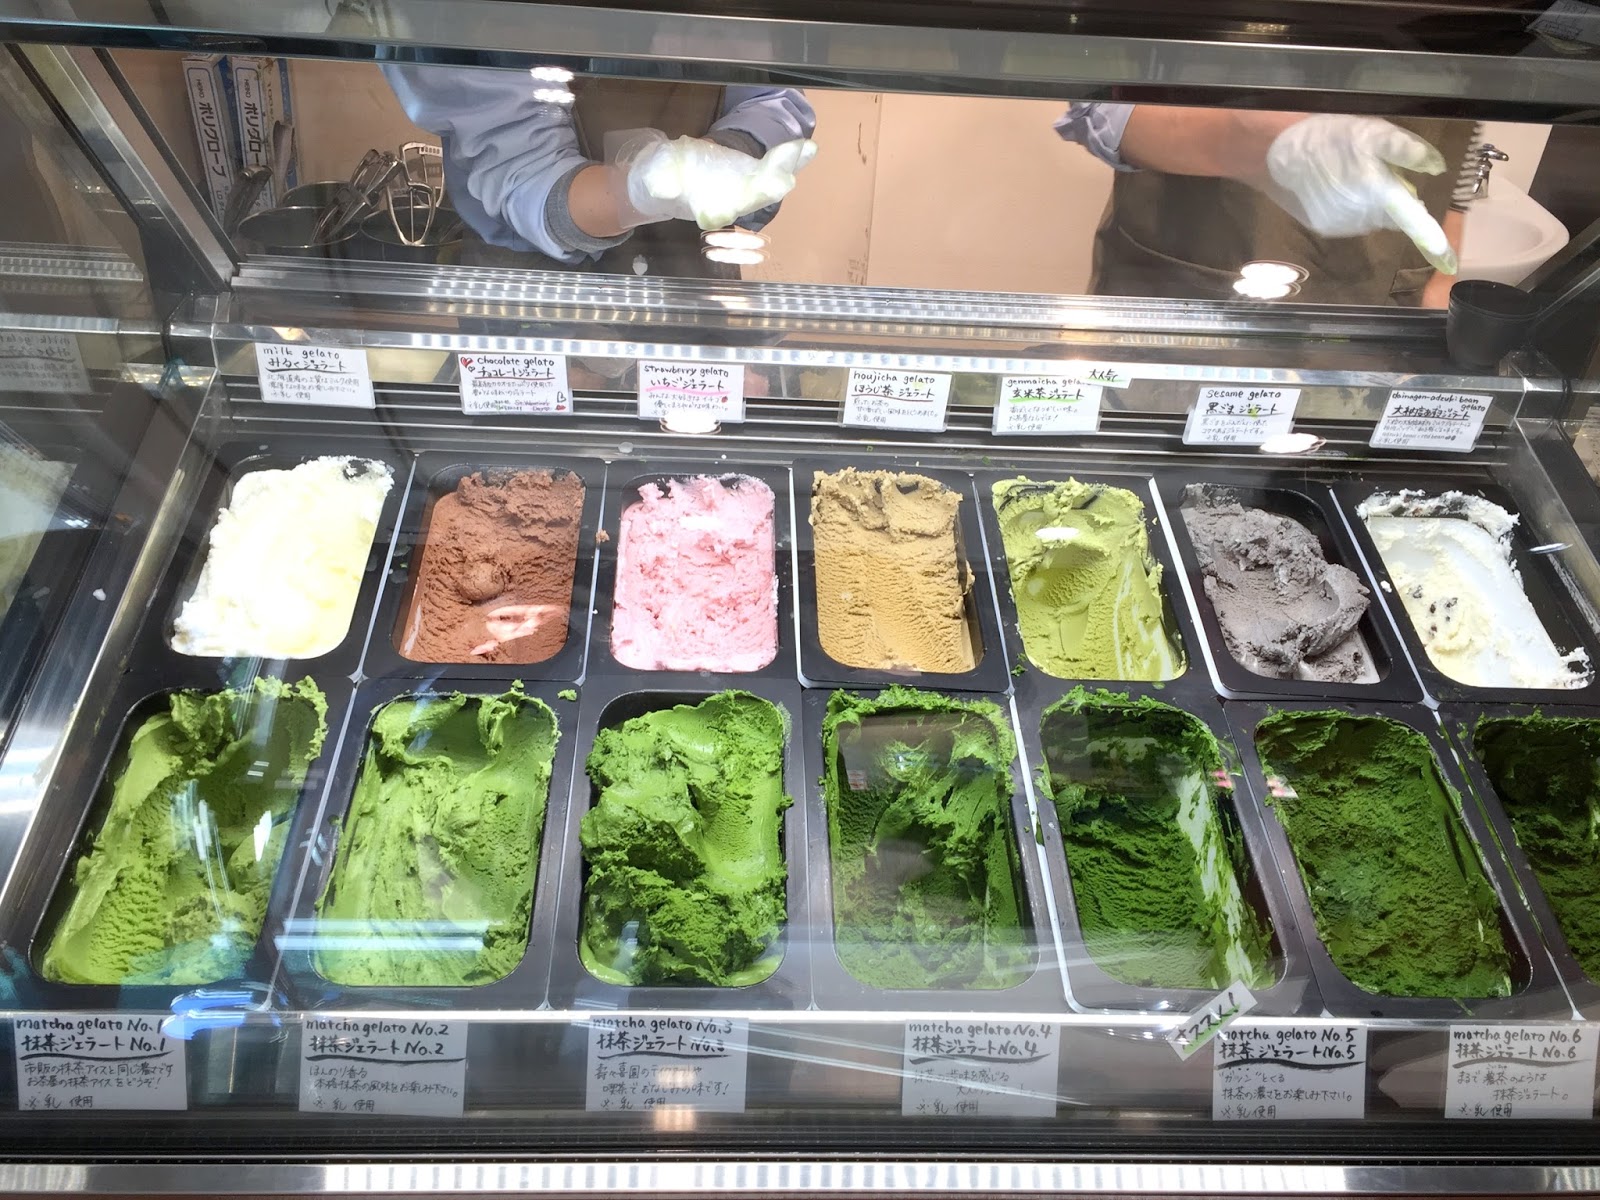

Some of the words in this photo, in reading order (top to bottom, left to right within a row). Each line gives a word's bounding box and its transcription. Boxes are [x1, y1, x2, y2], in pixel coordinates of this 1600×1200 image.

[244, 102, 261, 165] ポリグロー
[263, 347, 293, 356] milk
[302, 348, 340, 359] gelato
[268, 357, 347, 371] みるくジェラート
[523, 356, 554, 368] gelato
[478, 367, 553, 378] チョコレートジェラート
[644, 365, 697, 377] strawberry
[700, 366, 729, 378] gelato
[853, 371, 897, 384] houjicha
[903, 375, 935, 385] gelato
[1088, 368, 1118, 382] 大人気
[650, 376, 724, 391] いちごジェラート
[1007, 378, 1057, 387] genmaicha
[1247, 389, 1282, 401] gelato
[1461, 403, 1486, 412] gelato
[16, 1018, 74, 1030] matcha
[77, 1018, 122, 1035] gelato
[127, 1018, 162, 1034] No.1
[306, 1018, 360, 1031] matcha
[362, 1021, 407, 1038] gelato
[411, 1021, 449, 1036] No.2
[593, 1016, 647, 1030] matcha
[650, 1017, 693, 1034] gelato
[909, 1020, 964, 1035] matcha
[967, 1022, 1011, 1038] gelato
[1013, 1024, 1052, 1039] No.4
[21, 1033, 125, 1052] 抹茶ジェラート
[130, 1036, 166, 1052] No.1
[309, 1034, 401, 1054] 抹茶ジェラート
[404, 1041, 444, 1055] No.2
[596, 1031, 687, 1051] 抹茶ジェラート
[912, 1034, 998, 1054] 抹茶ジェラート
[1000, 1040, 1039, 1056] No.4
[1277, 1029, 1317, 1046] gelato
[1321, 1028, 1358, 1042] No.5
[1453, 1028, 1501, 1041] matcha
[1504, 1029, 1546, 1045] gelato
[1549, 1030, 1582, 1043] No.6
[1219, 1042, 1322, 1060] 抹茶ジェラート
[1323, 1044, 1357, 1059] No.5
[1455, 1042, 1538, 1059] 抹茶ジェラート
[1542, 1046, 1577, 1059] No.6
[309, 1065, 368, 1079] ほんのり香る
